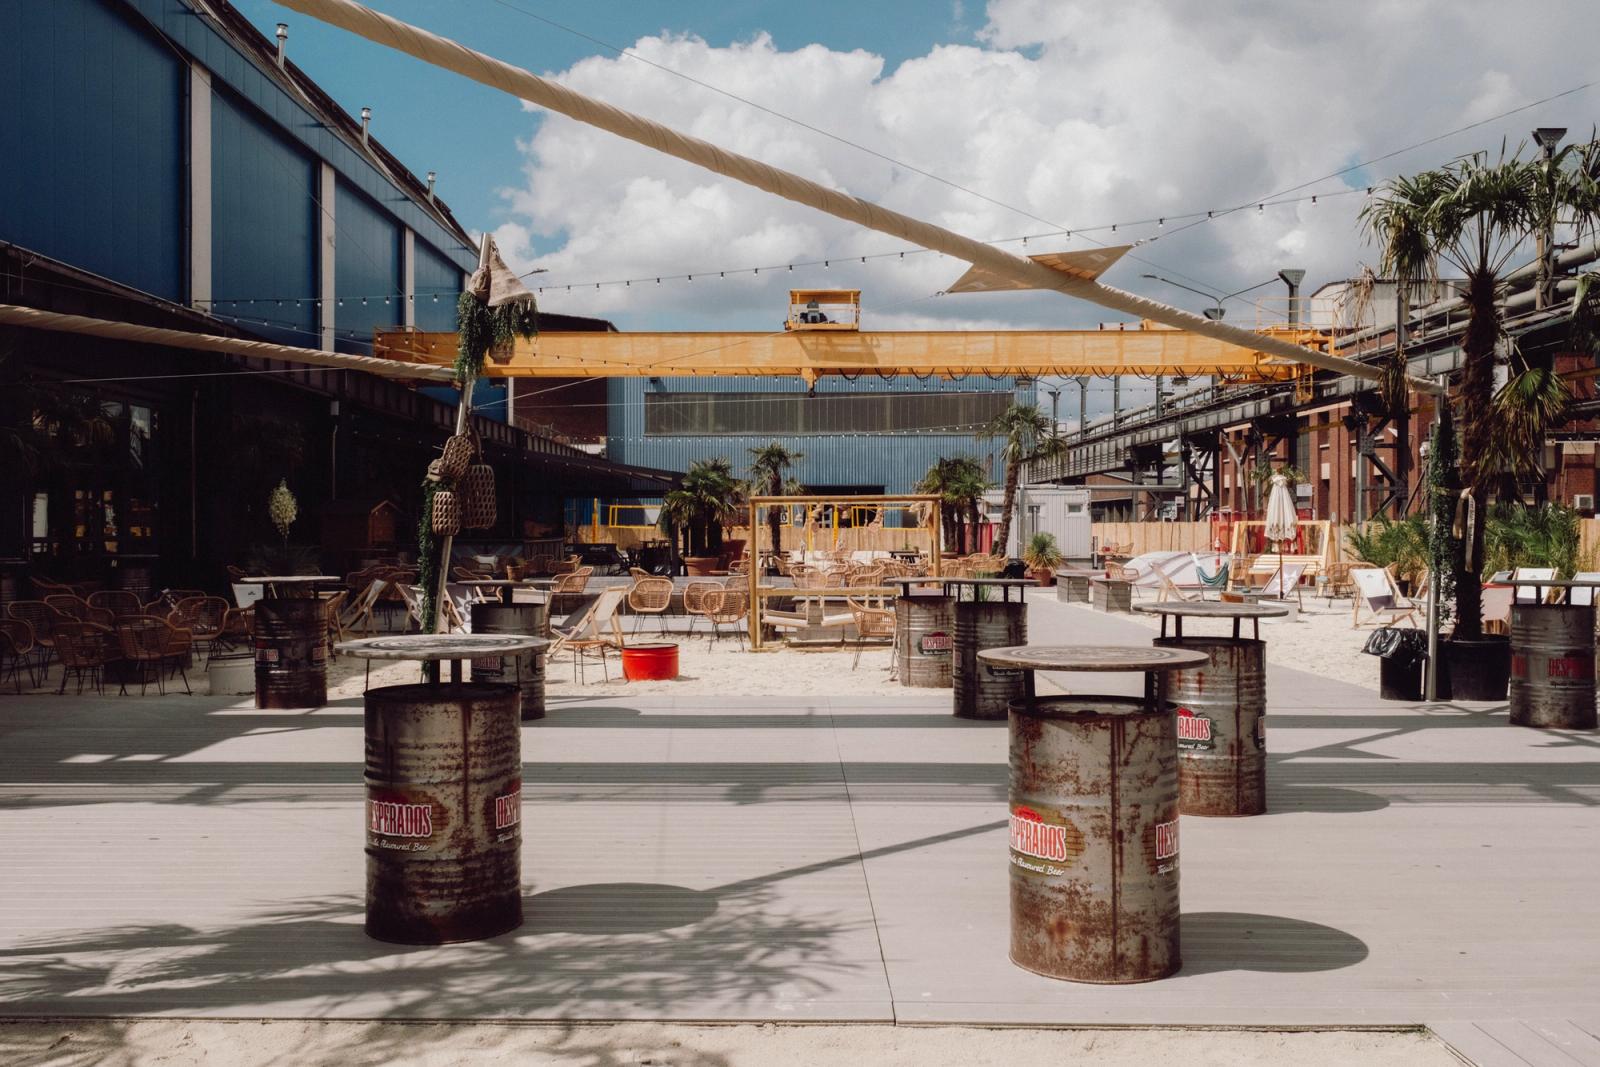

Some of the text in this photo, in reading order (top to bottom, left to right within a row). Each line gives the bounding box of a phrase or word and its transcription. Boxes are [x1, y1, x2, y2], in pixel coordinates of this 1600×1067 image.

[381, 840, 411, 850] Flavoured
[413, 842, 431, 851] Beer
[1017, 857, 1045, 873] Flavoured
[1046, 864, 1064, 876] Beer
